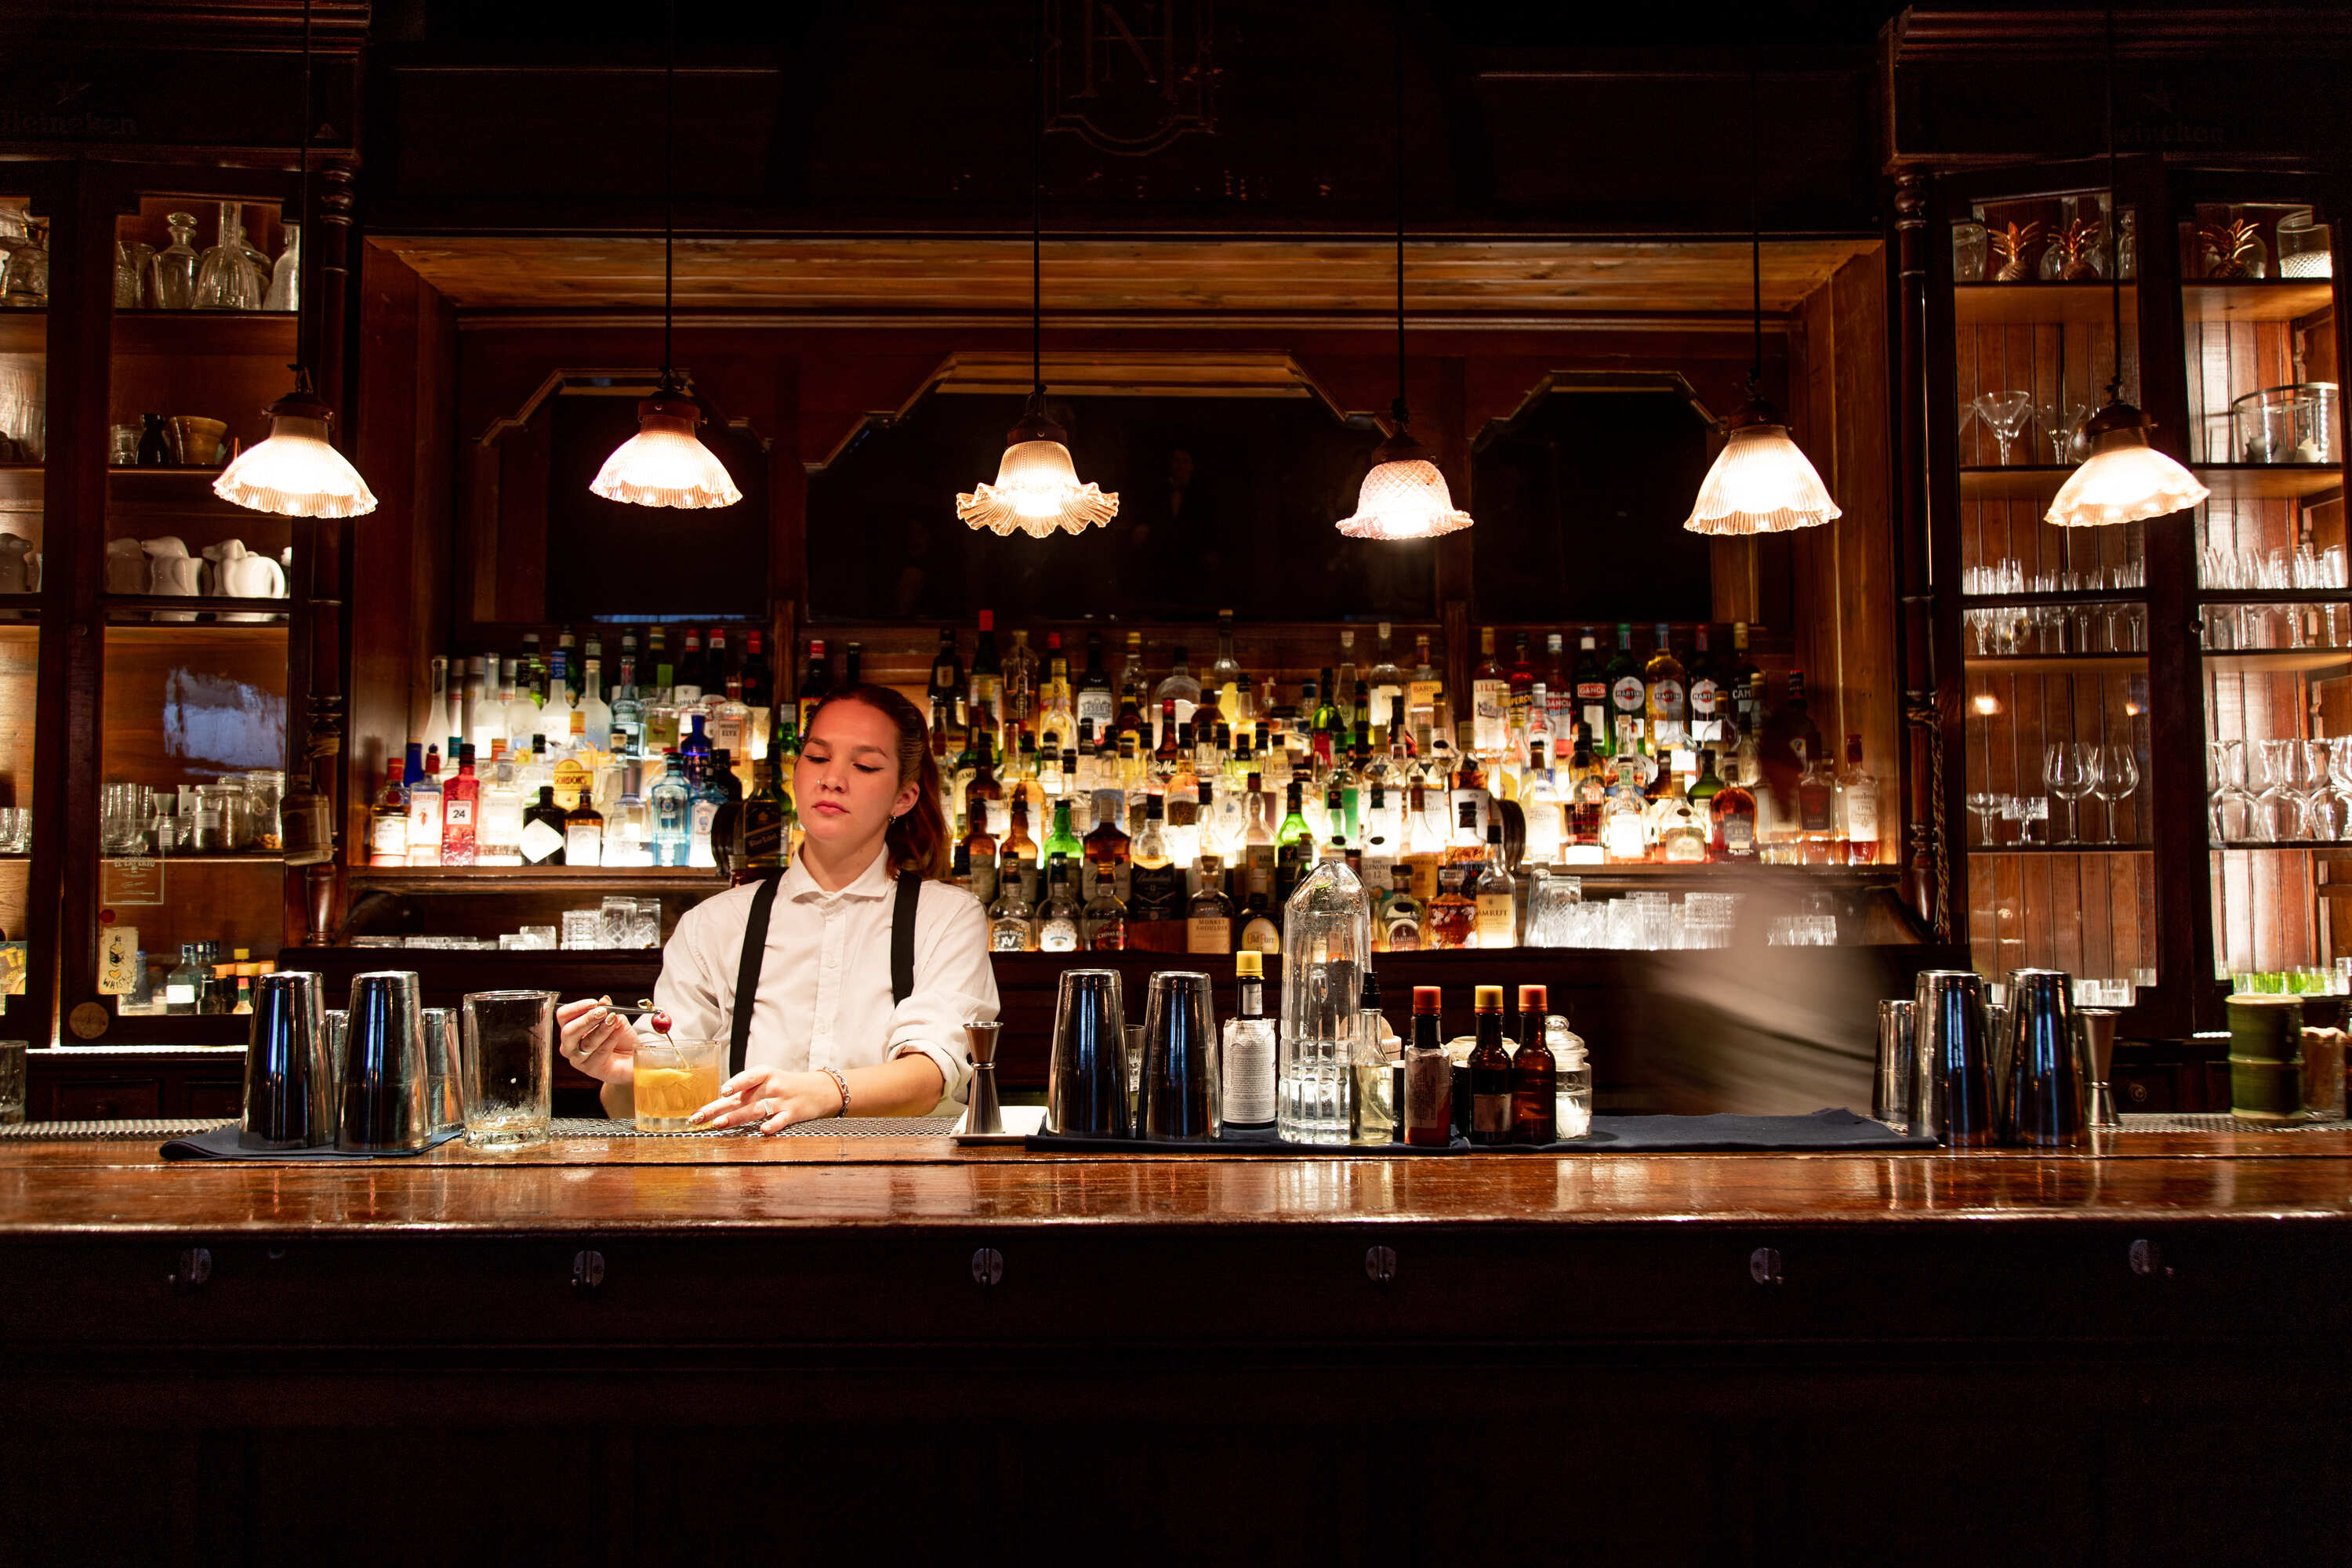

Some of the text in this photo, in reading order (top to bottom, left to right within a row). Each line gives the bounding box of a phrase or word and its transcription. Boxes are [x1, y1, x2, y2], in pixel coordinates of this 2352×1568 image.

[1475, 683, 1497, 692] LILL
[1615, 689, 1643, 698] MARTINI
[1655, 691, 1682, 701] MARTINI
[1692, 692, 1715, 701] MARTI
[1732, 689, 1751, 700] CAM
[956, 771, 978, 782] JAME
[452, 809, 466, 819] 24
